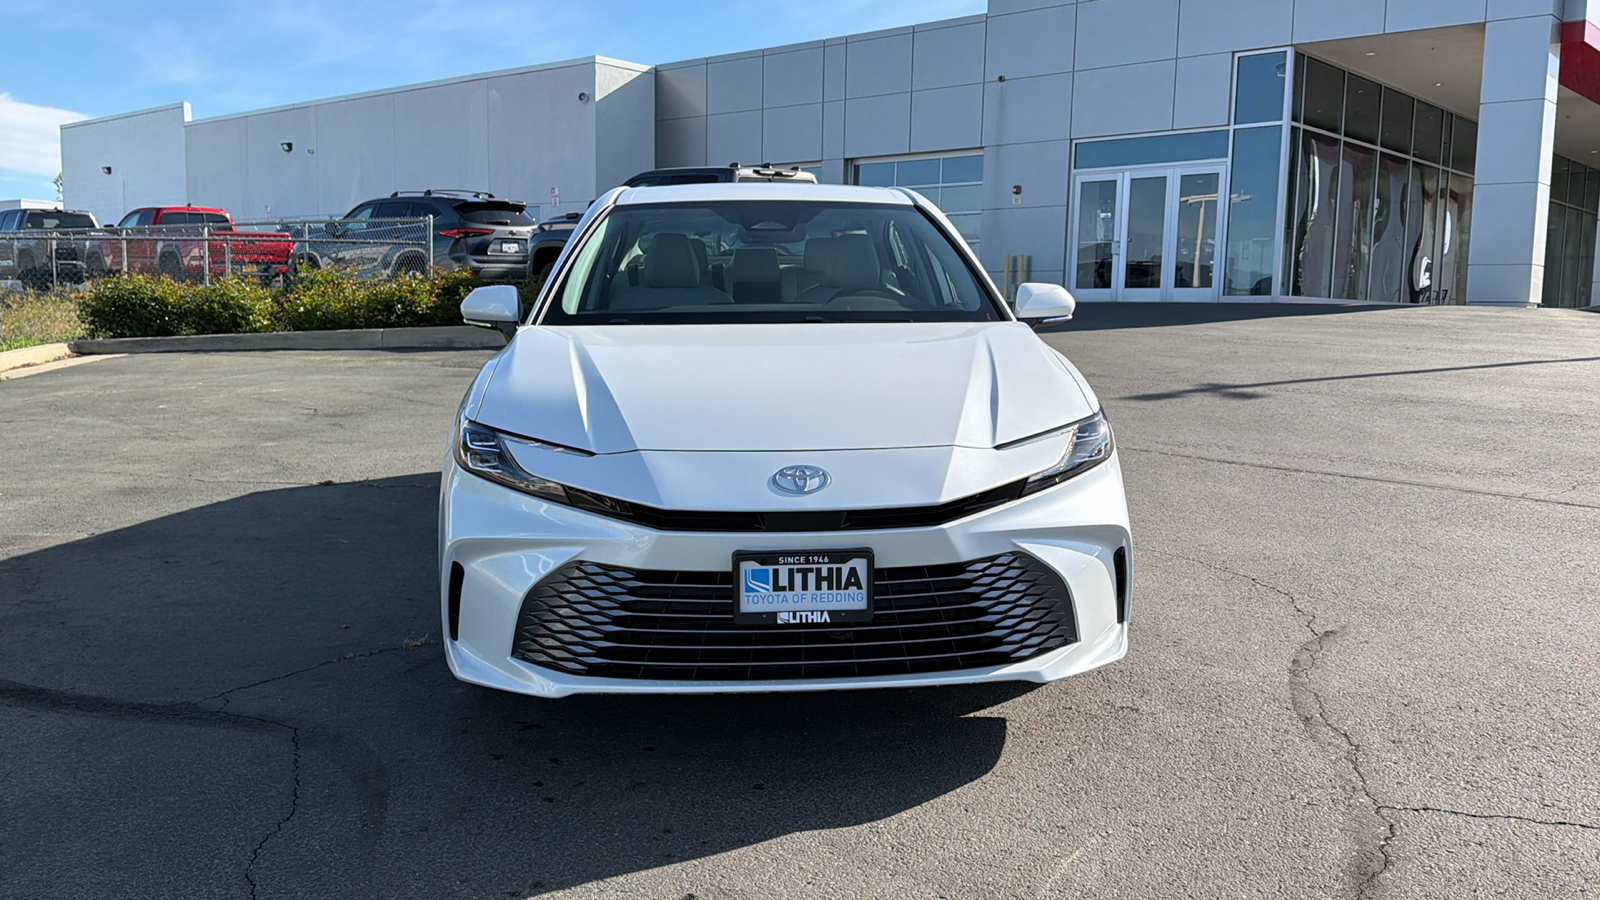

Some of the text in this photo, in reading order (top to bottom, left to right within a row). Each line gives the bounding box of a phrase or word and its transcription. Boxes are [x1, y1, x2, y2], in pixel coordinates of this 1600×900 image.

[778, 555, 829, 564] SINCE 1946
[772, 566, 863, 592] LITHIA
[745, 592, 864, 605] TOYOTA OF REDDING
[789, 611, 831, 623] LITHIA
